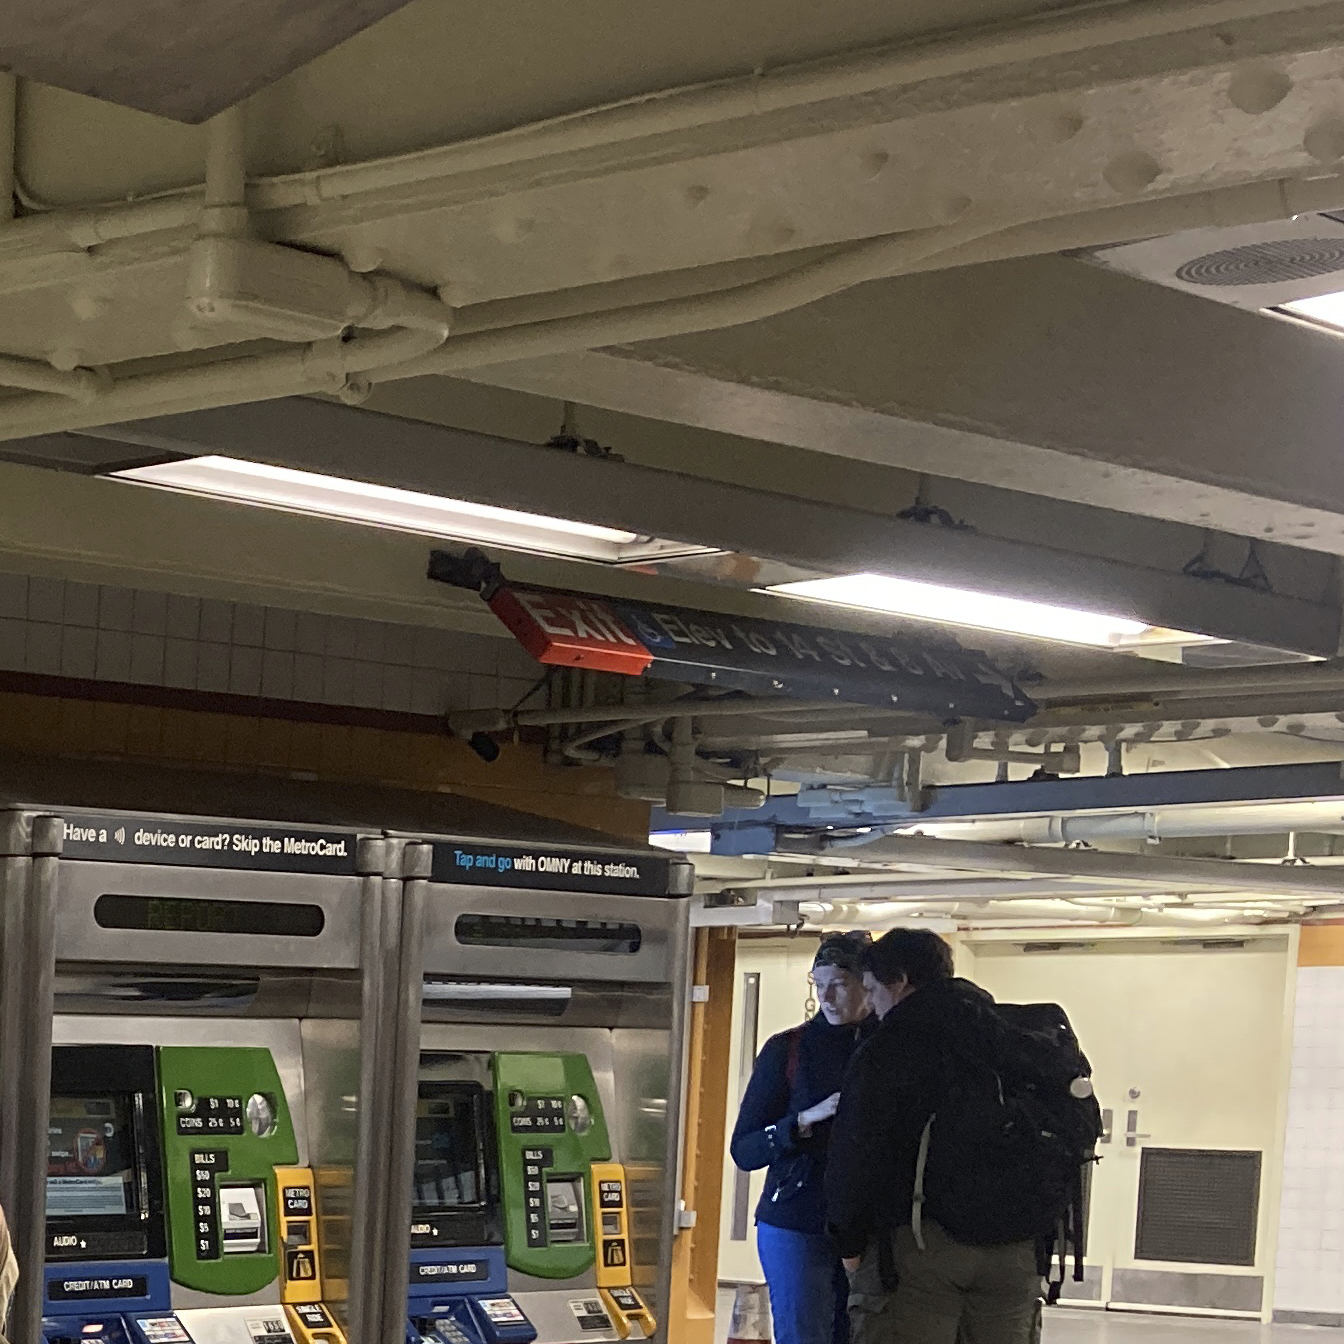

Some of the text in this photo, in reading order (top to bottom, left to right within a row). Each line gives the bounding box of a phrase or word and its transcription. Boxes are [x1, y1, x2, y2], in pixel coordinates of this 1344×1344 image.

[517, 592, 637, 646] Exit
[653, 613, 732, 648] Elev
[731, 624, 778, 656] to
[63, 823, 348, 857] Have a device or card? Skip the MetroCard.
[454, 850, 640, 879] Tap and go with OMNY at this station.
[194, 1153, 216, 1164] BILLS
[53, 1235, 78, 1247] AUDIO
[112, 1278, 133, 1289] CARD
